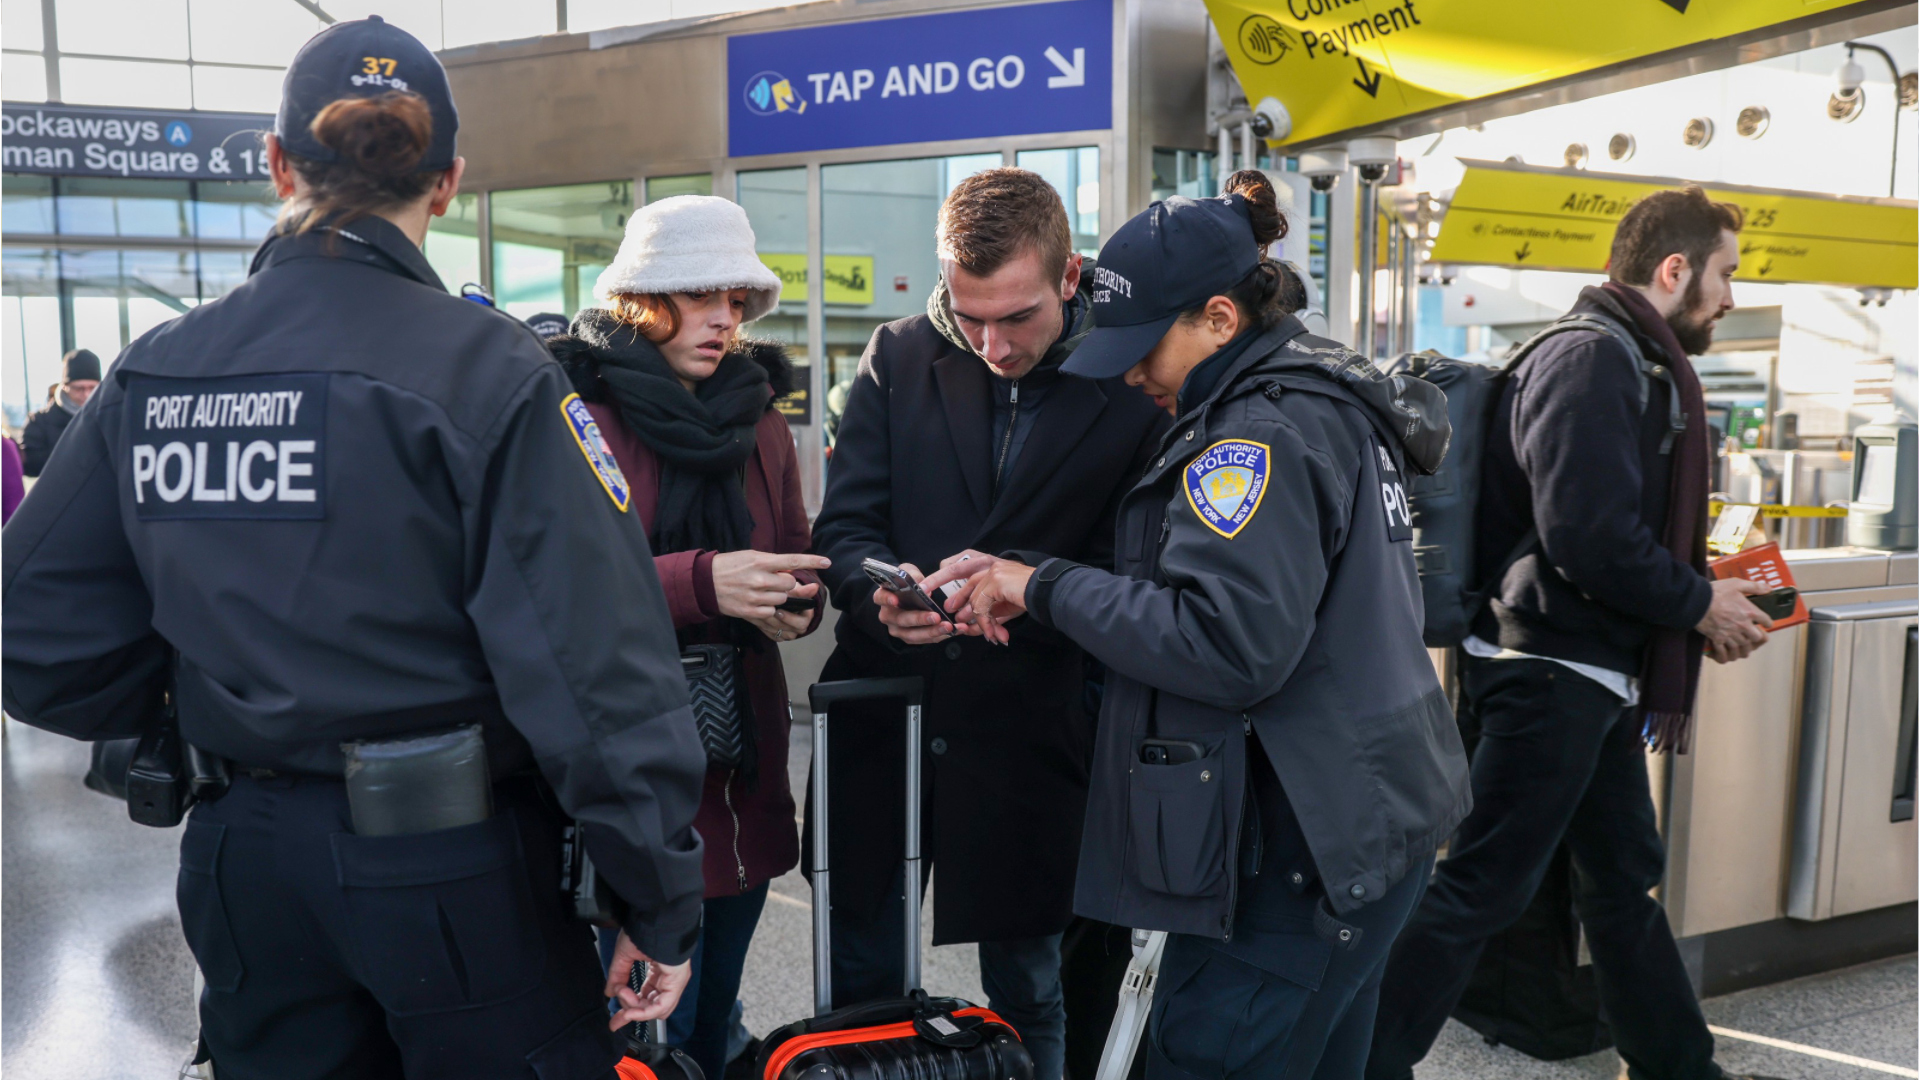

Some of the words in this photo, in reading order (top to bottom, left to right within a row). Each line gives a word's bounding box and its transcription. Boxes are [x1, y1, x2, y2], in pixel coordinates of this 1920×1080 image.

[1301, 0, 1421, 59] Payment
[362, 56, 398, 77] 37
[807, 68, 875, 104] TAP
[880, 61, 960, 98] AND
[967, 54, 1025, 91] GO
[168, 124, 189, 144] A
[2, 145, 75, 169] man
[83, 141, 200, 177] Square
[207, 146, 232, 174] &
[1491, 222, 1551, 239] Contactless
[1553, 228, 1596, 243] Payment
[144, 395, 194, 430] PORT
[191, 391, 303, 428] AUTHORITY
[132, 440, 317, 504] POLICE
[1190, 451, 1211, 470] PORT
[1213, 443, 1263, 457] AUTHORITY
[1194, 451, 1259, 477] POLICE
[1192, 487, 1206, 505] NEW
[1202, 504, 1222, 524] YORK
[1232, 503, 1251, 525] NEW
[1247, 473, 1264, 504] JERSEY
[1382, 481, 1413, 528] PO
